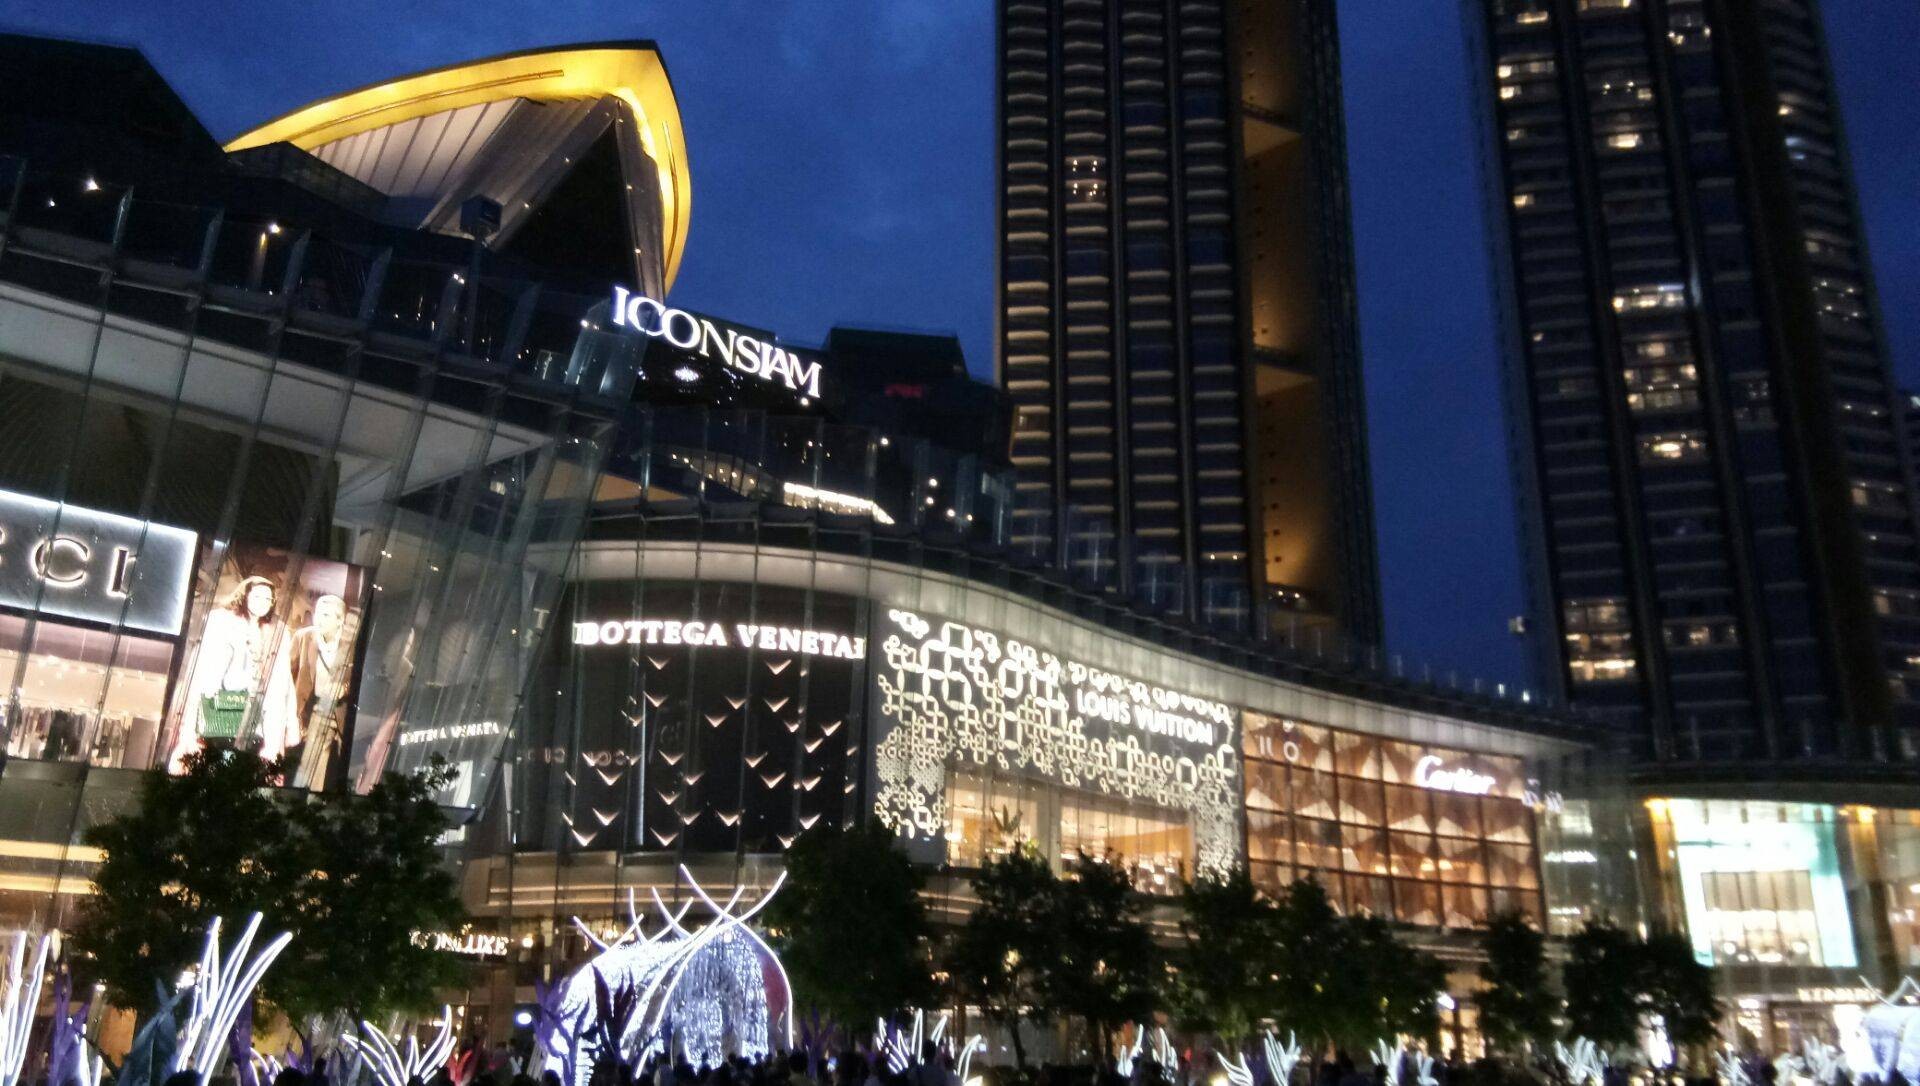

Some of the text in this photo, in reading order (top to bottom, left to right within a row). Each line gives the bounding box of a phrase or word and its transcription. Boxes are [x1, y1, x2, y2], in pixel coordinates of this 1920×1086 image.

[613, 286, 823, 398] ICONSIAM
[0, 526, 137, 599] CI
[573, 620, 728, 646] BOTTEGA
[1076, 688, 1214, 747] LOUIS VUITTON
[1415, 754, 1497, 795] Cartier
[408, 930, 508, 956] CONLUXE
